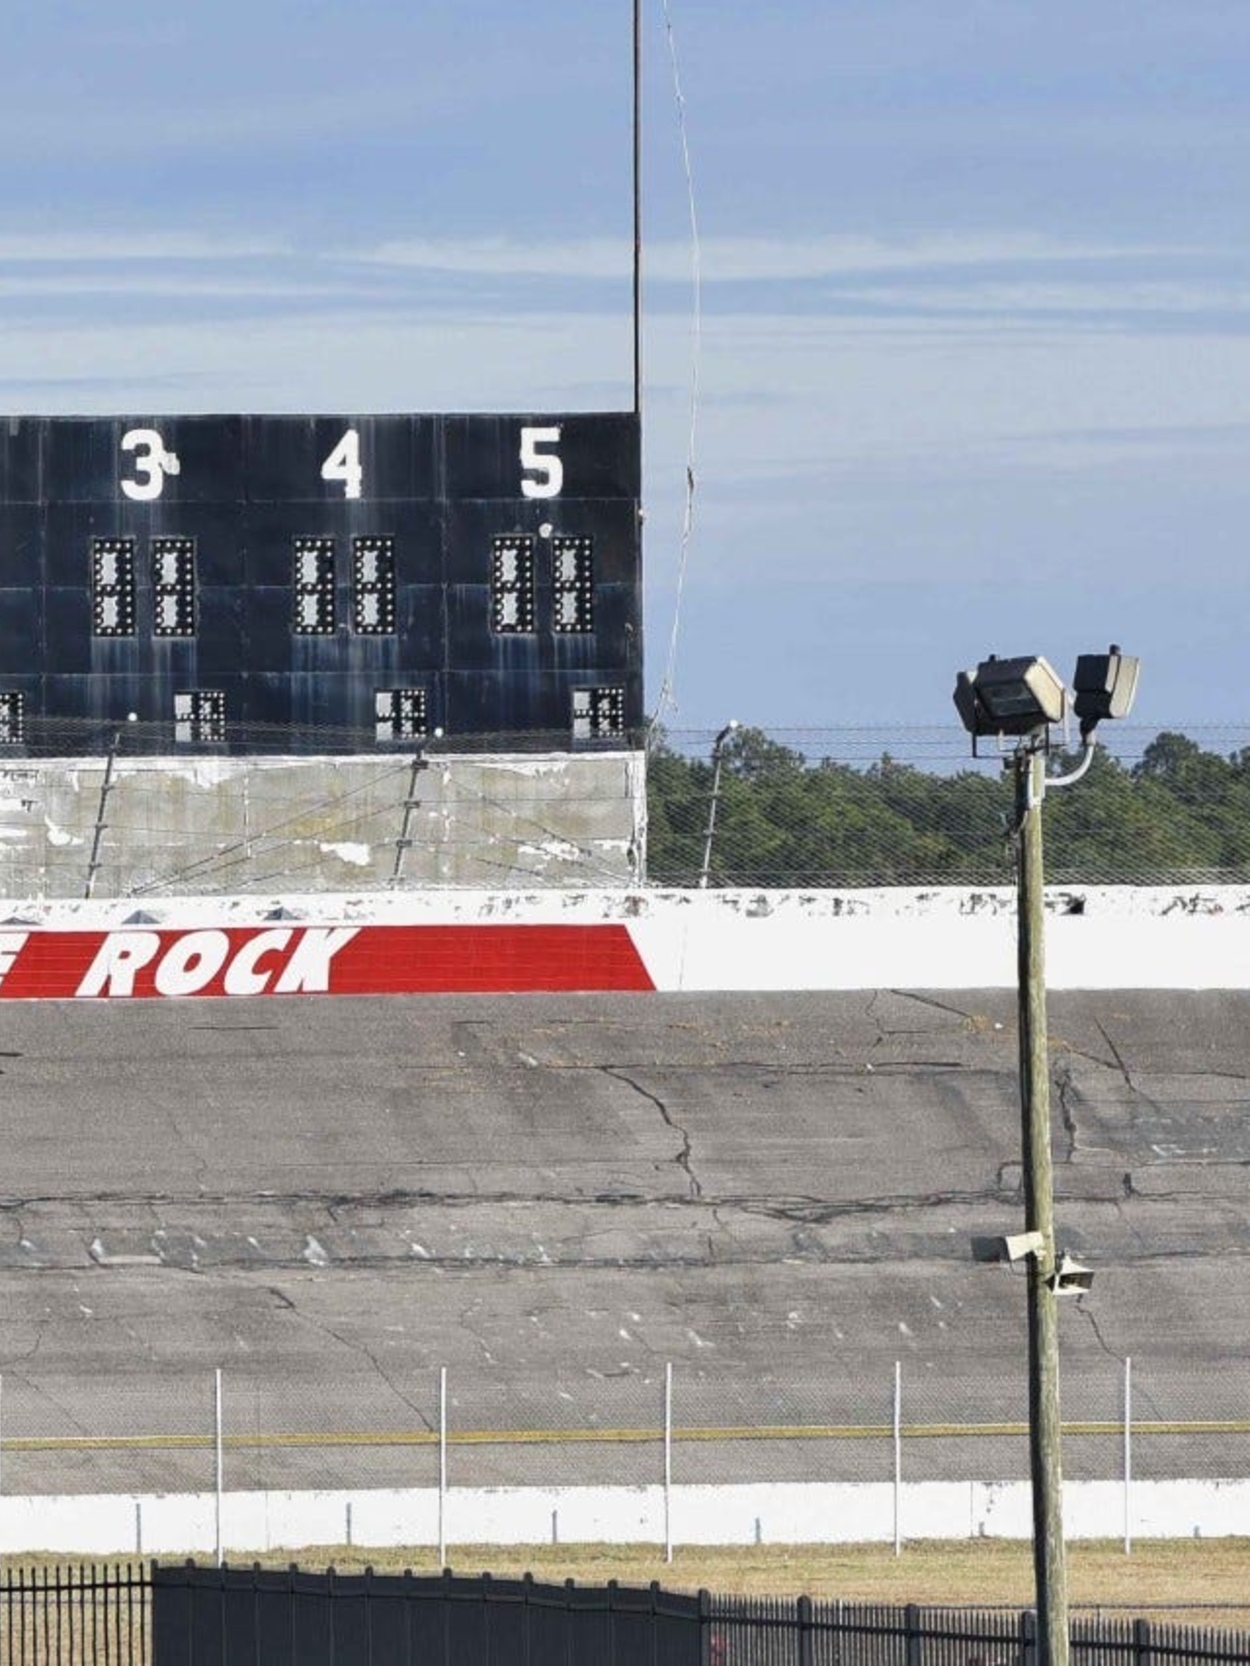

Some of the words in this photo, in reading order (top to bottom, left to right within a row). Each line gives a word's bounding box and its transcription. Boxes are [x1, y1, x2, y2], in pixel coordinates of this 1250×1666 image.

[121, 429, 165, 500] 3
[321, 429, 362, 498] 4
[520, 427, 563, 498] 5
[74, 927, 362, 997] ROCK
